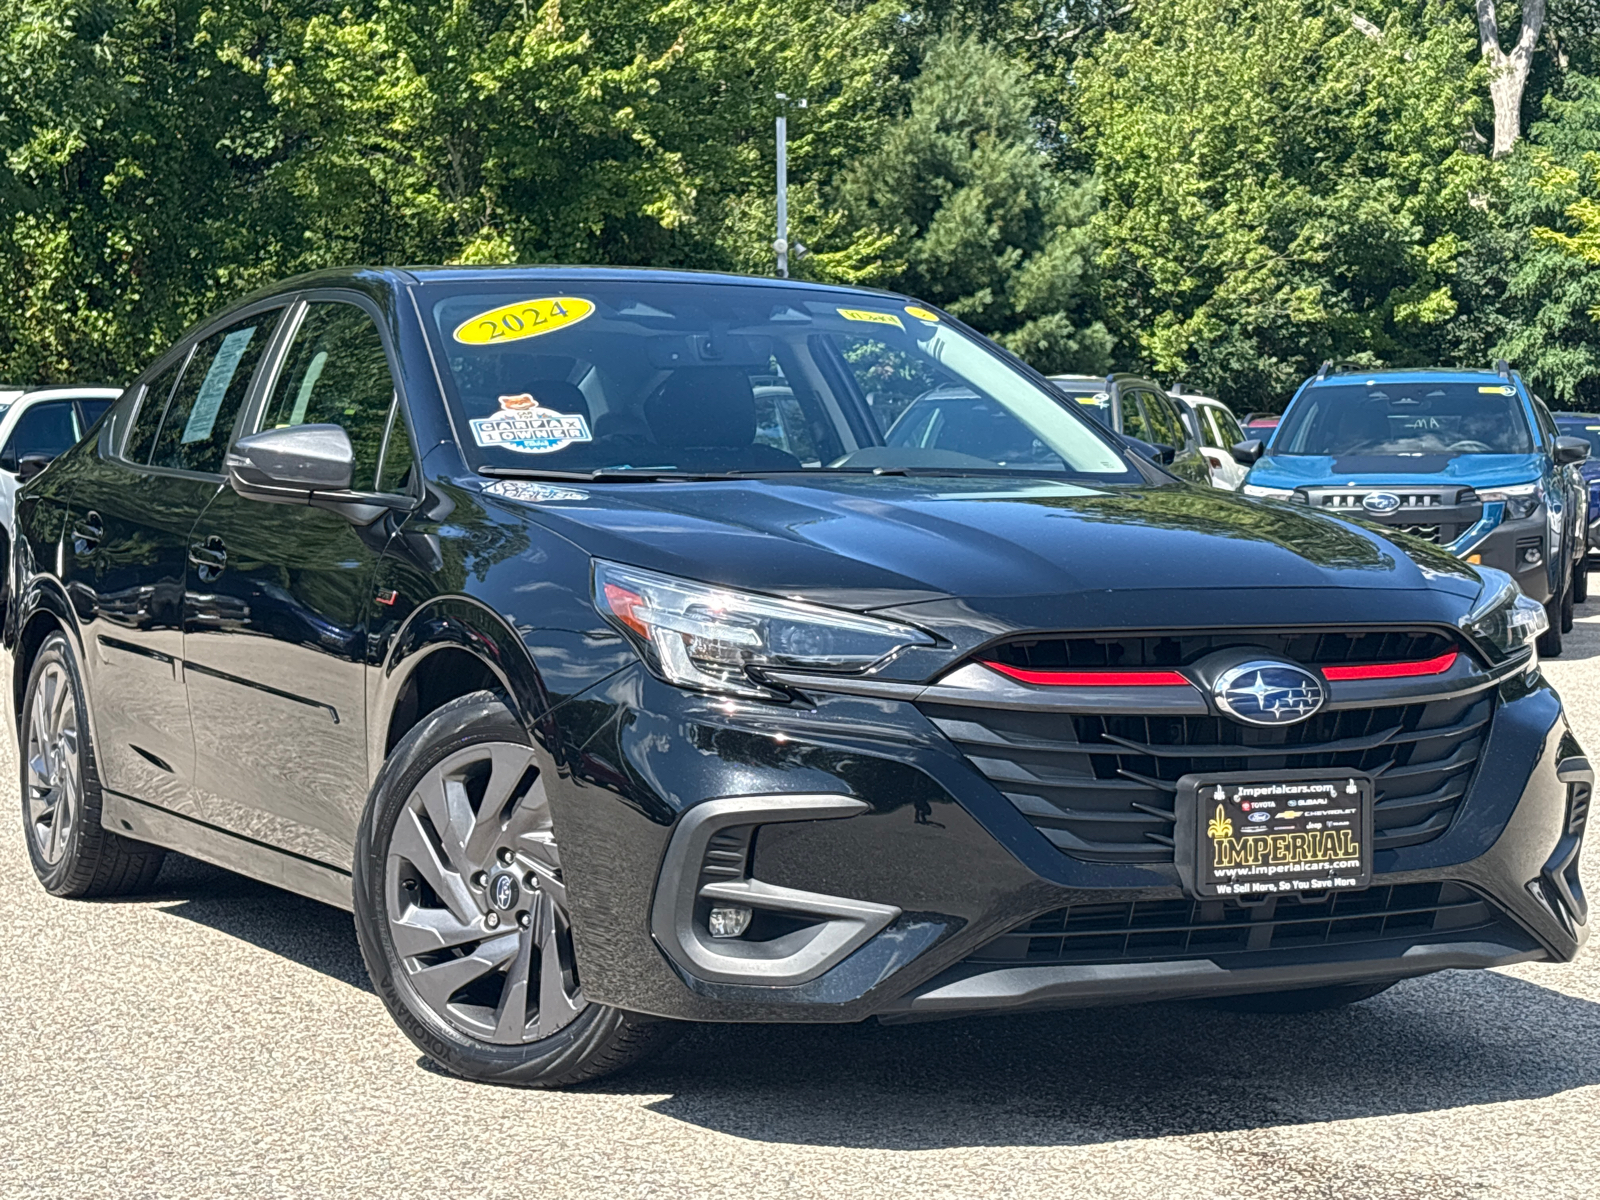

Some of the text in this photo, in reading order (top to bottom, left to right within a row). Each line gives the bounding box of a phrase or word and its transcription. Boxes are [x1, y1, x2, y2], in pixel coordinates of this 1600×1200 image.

[479, 301, 569, 339] 2024
[480, 419, 577, 431] CARFAX
[500, 428, 585, 441] OWNER
[1238, 784, 1334, 797] Imperialcars.com
[1250, 801, 1276, 809] TOYOTA
[1304, 808, 1357, 816] CHEVROLET
[1213, 830, 1359, 867] IMPERIAL
[1214, 860, 1359, 877] www.imperialcars.com
[1217, 877, 1356, 894] We Sell More, So You Save More
[380, 974, 451, 1063] YOKOHAMA
